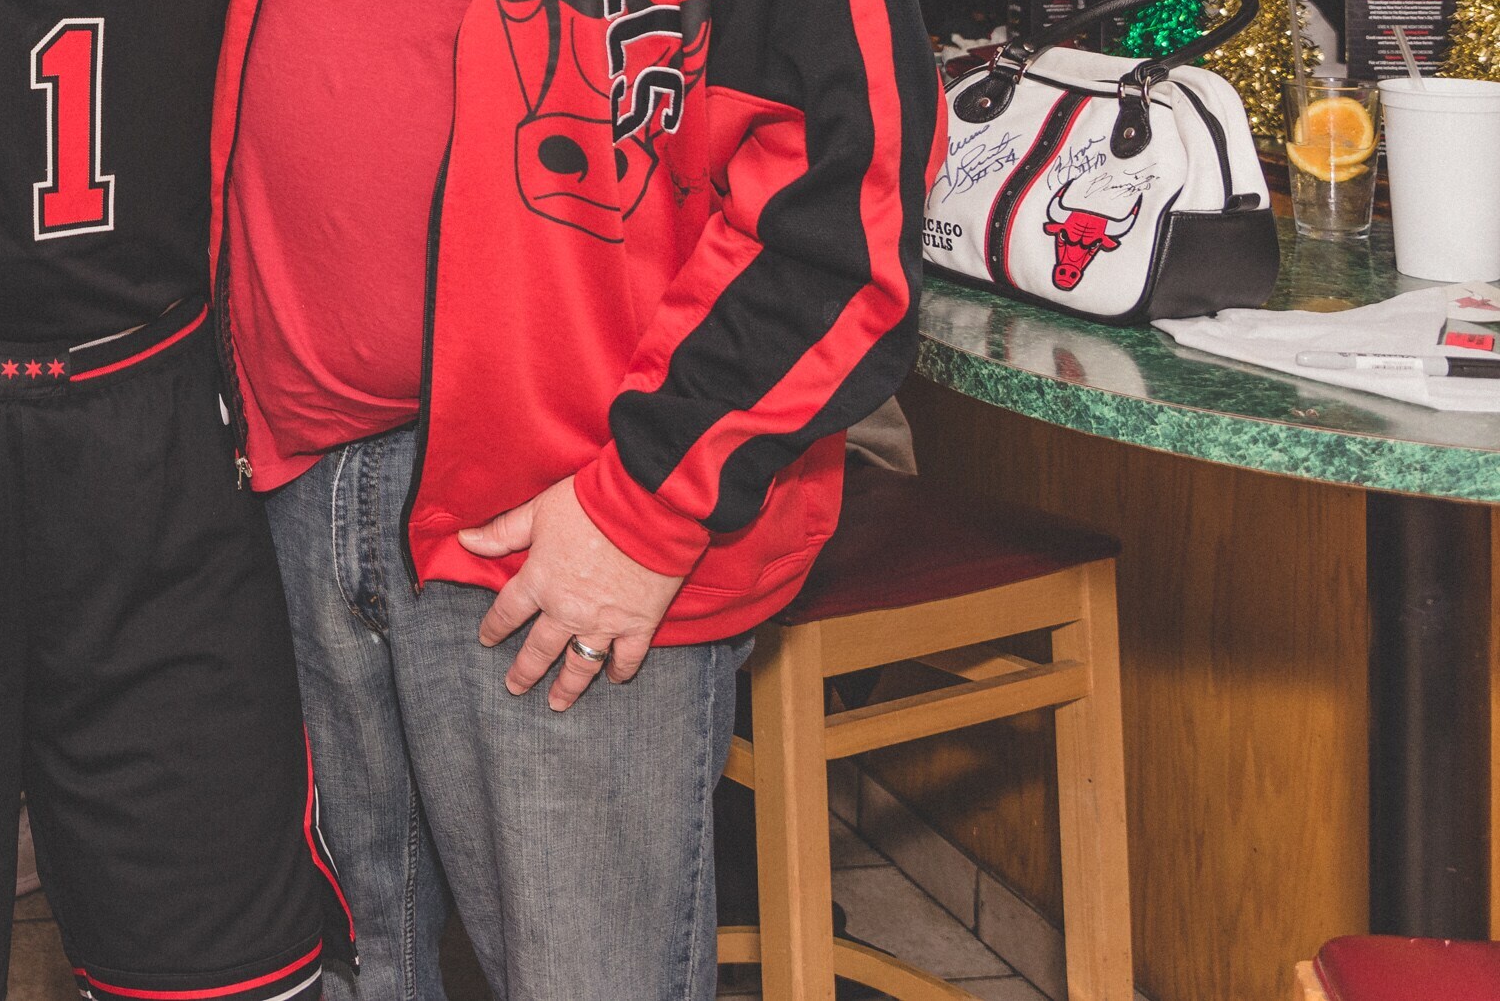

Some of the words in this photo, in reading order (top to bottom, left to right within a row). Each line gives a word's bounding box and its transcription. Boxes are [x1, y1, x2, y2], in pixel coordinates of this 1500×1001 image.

[30, 17, 115, 241] 1
[923, 217, 963, 238] ICAGO
[922, 233, 953, 251] ULLS
